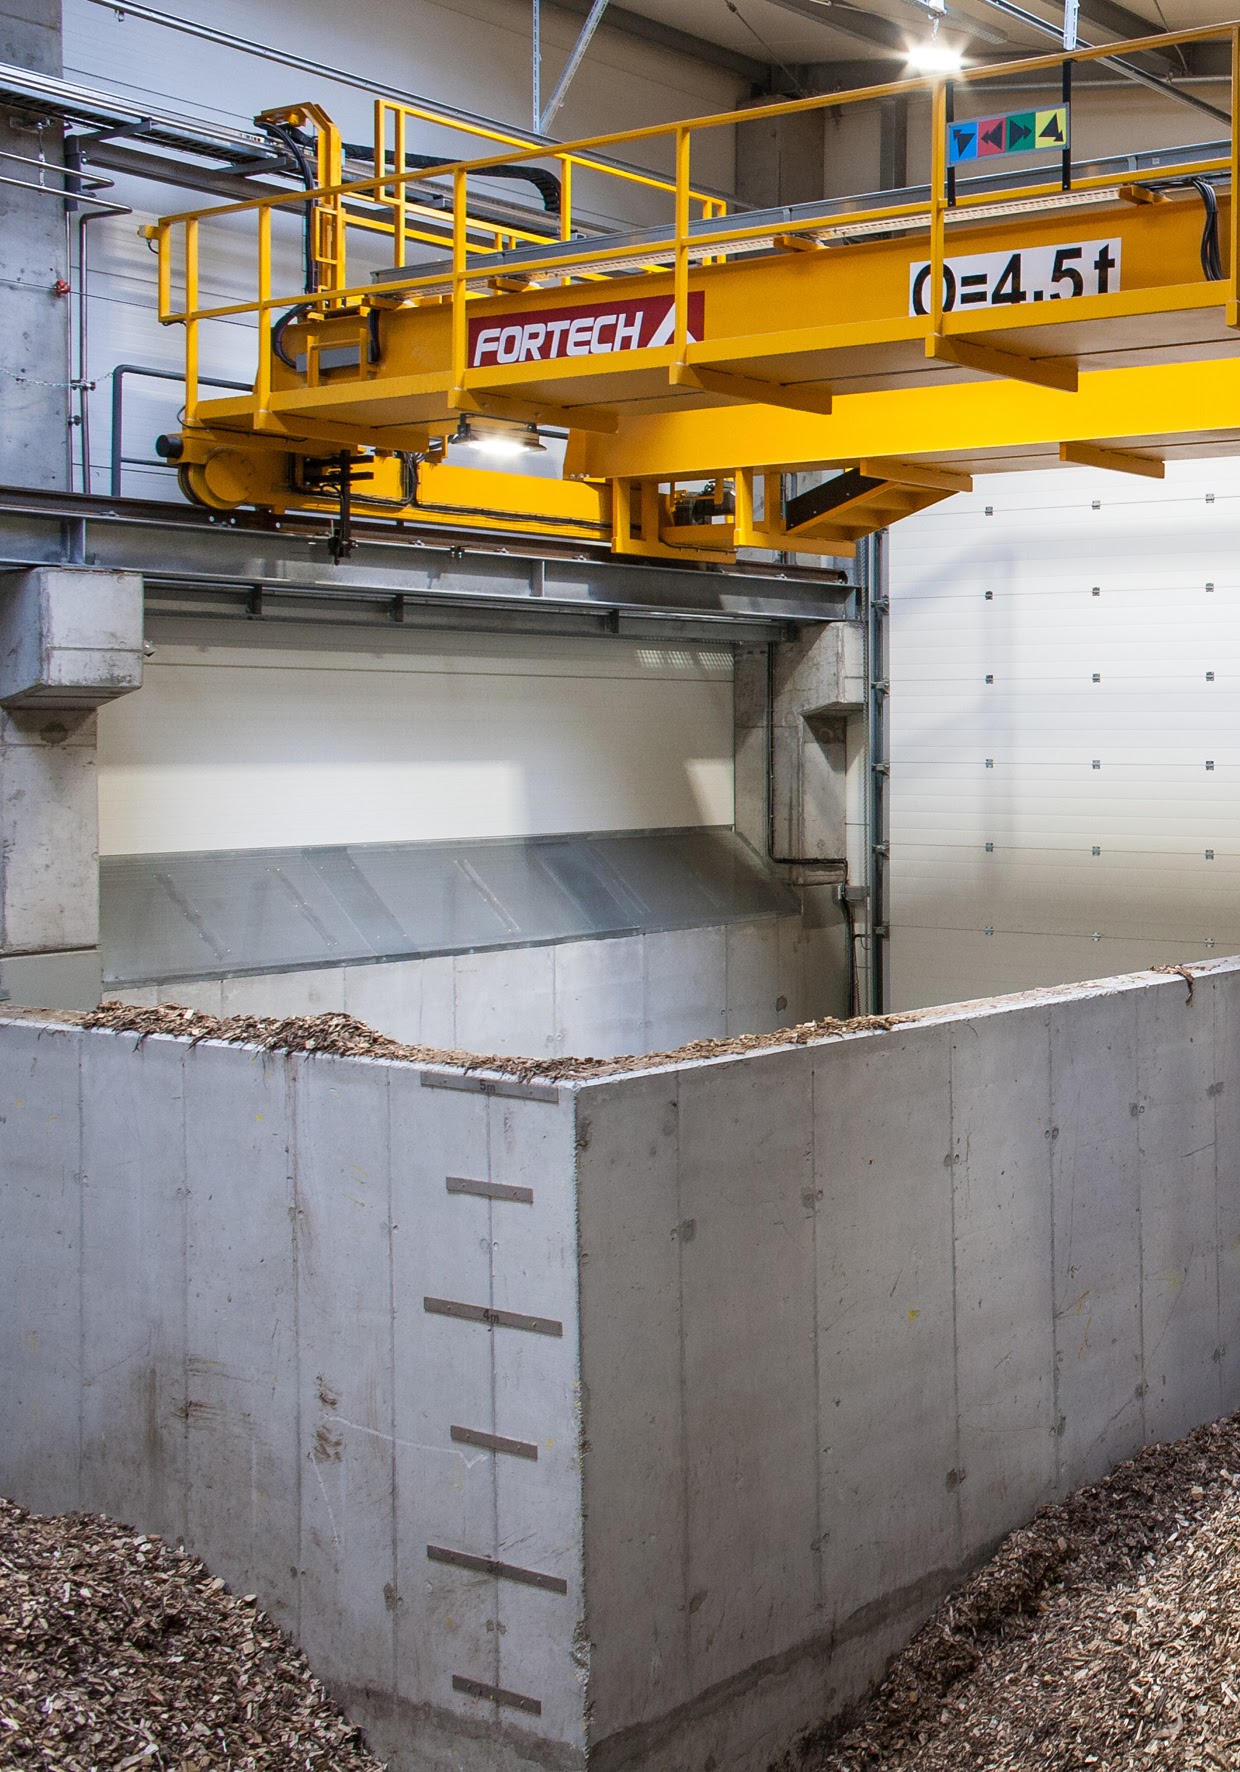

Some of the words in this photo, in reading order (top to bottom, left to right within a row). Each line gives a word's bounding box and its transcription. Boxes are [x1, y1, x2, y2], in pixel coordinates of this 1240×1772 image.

[473, 311, 643, 367] FORTECH
[480, 1079, 495, 1093] 5m
[483, 1308, 499, 1324] 4m
